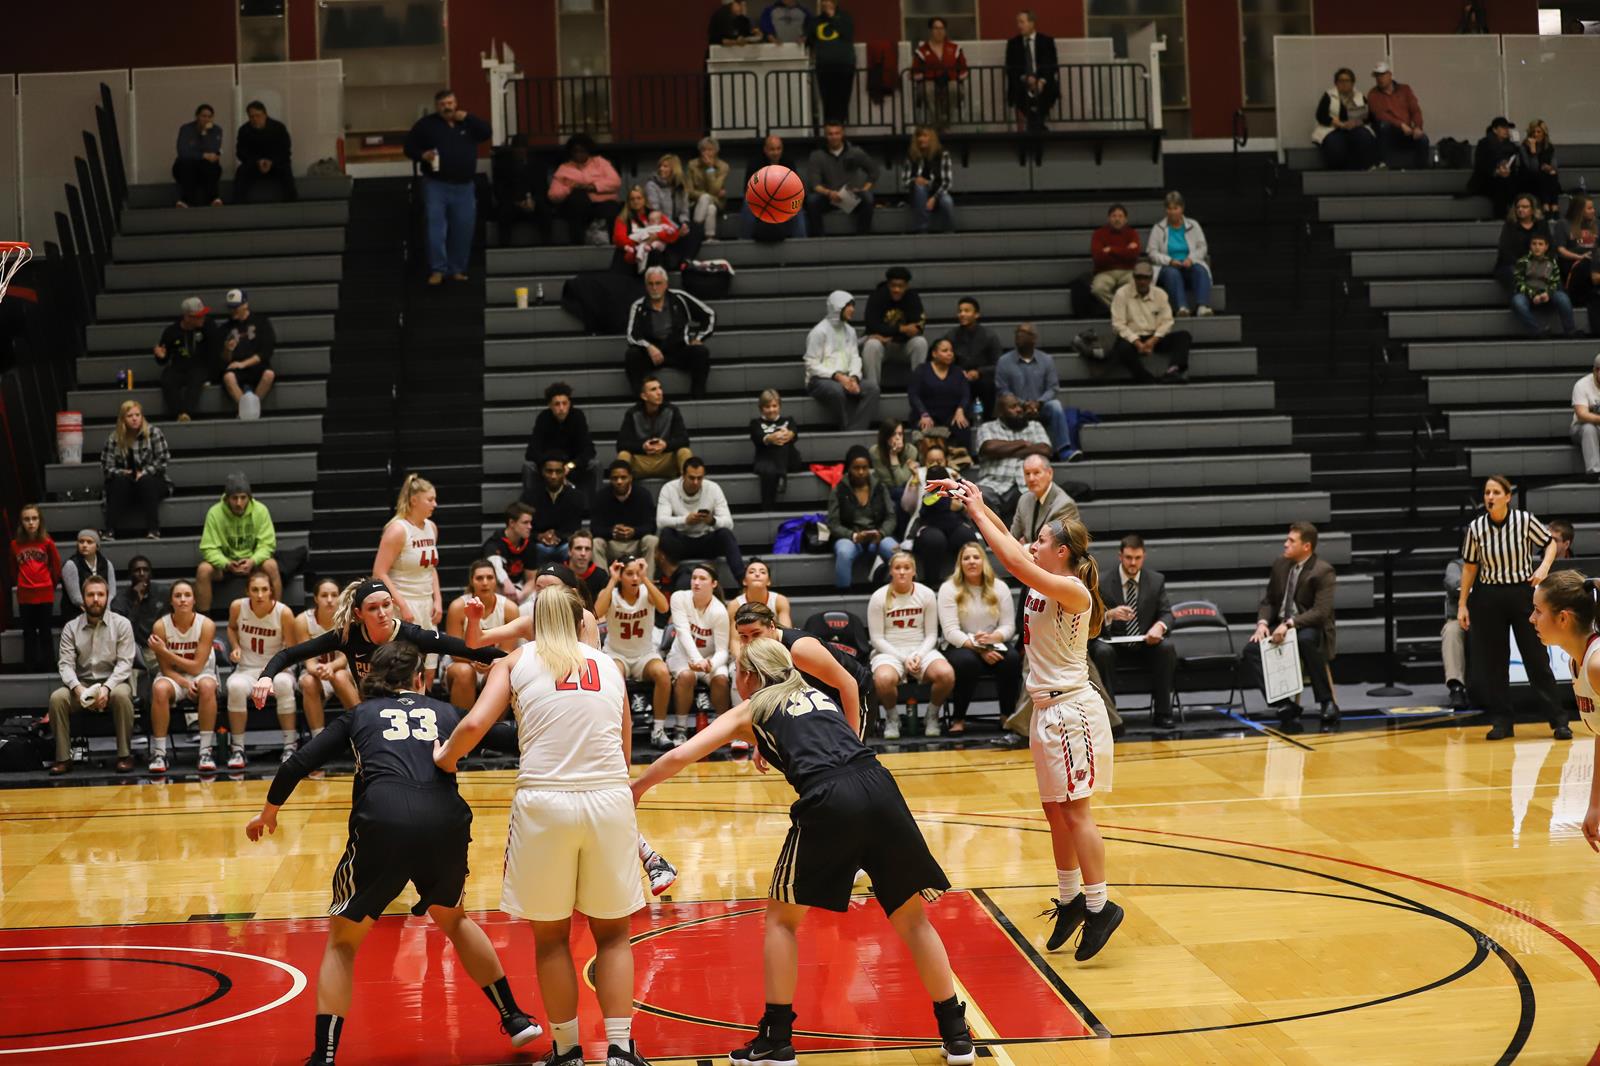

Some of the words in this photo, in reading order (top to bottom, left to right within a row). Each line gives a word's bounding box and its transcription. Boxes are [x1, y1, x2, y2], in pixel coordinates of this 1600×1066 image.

[614, 607, 649, 620] PANTHERS
[241, 623, 277, 637] PANTHERS
[620, 620, 645, 640] 34
[250, 636, 265, 655] 11
[554, 658, 601, 692] 20
[379, 707, 439, 741] 33
